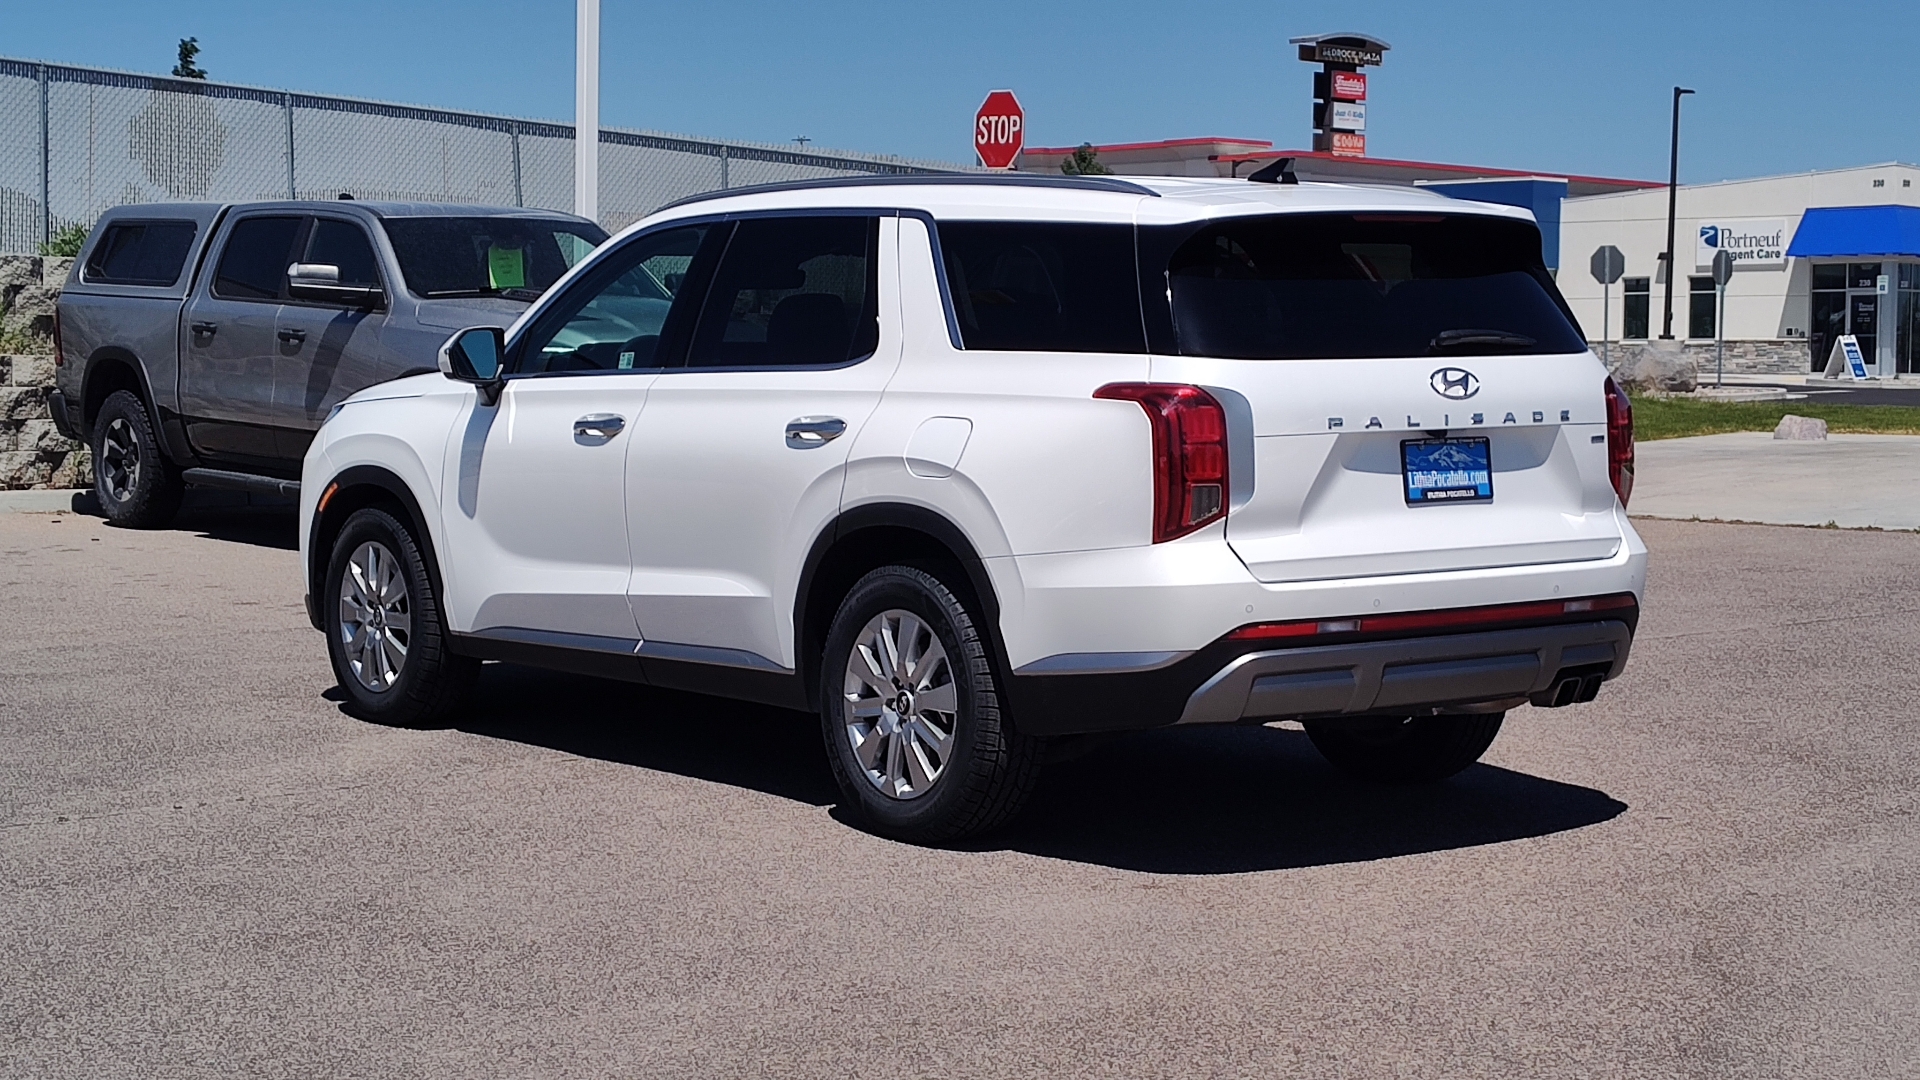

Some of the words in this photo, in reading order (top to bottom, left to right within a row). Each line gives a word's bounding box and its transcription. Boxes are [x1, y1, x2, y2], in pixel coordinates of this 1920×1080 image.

[1322, 47, 1357, 59] BEDROCK
[1358, 51, 1380, 61] PLAZA
[977, 115, 1020, 145] STOP
[1720, 228, 1781, 248] Portneuf
[1727, 250, 1754, 261] gent
[1757, 249, 1781, 259] Care
[1859, 279, 1871, 287] 230
[1327, 410, 1570, 430] PALISADE
[1408, 470, 1488, 489] LithiaPocatello.com
